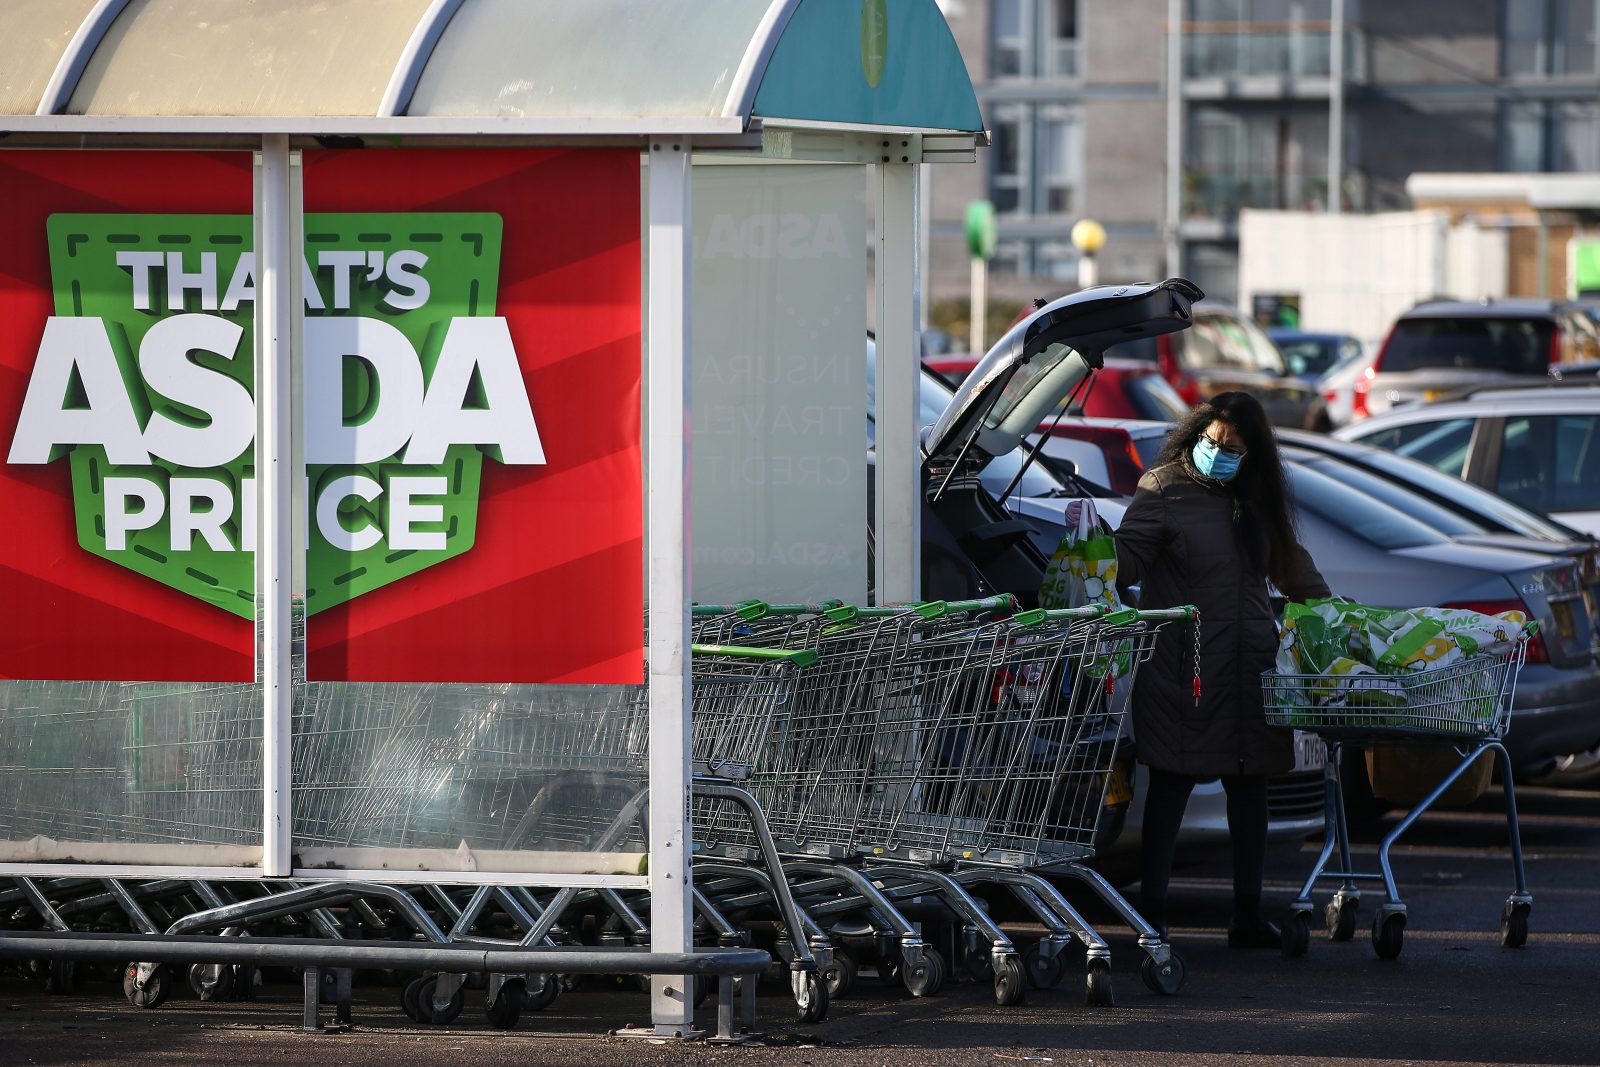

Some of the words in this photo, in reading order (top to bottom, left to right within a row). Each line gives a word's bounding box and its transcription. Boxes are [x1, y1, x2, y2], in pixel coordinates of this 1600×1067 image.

[116, 250, 430, 310] THAT'S
[6, 313, 547, 468] ASDA
[104, 476, 447, 551] PRICE
